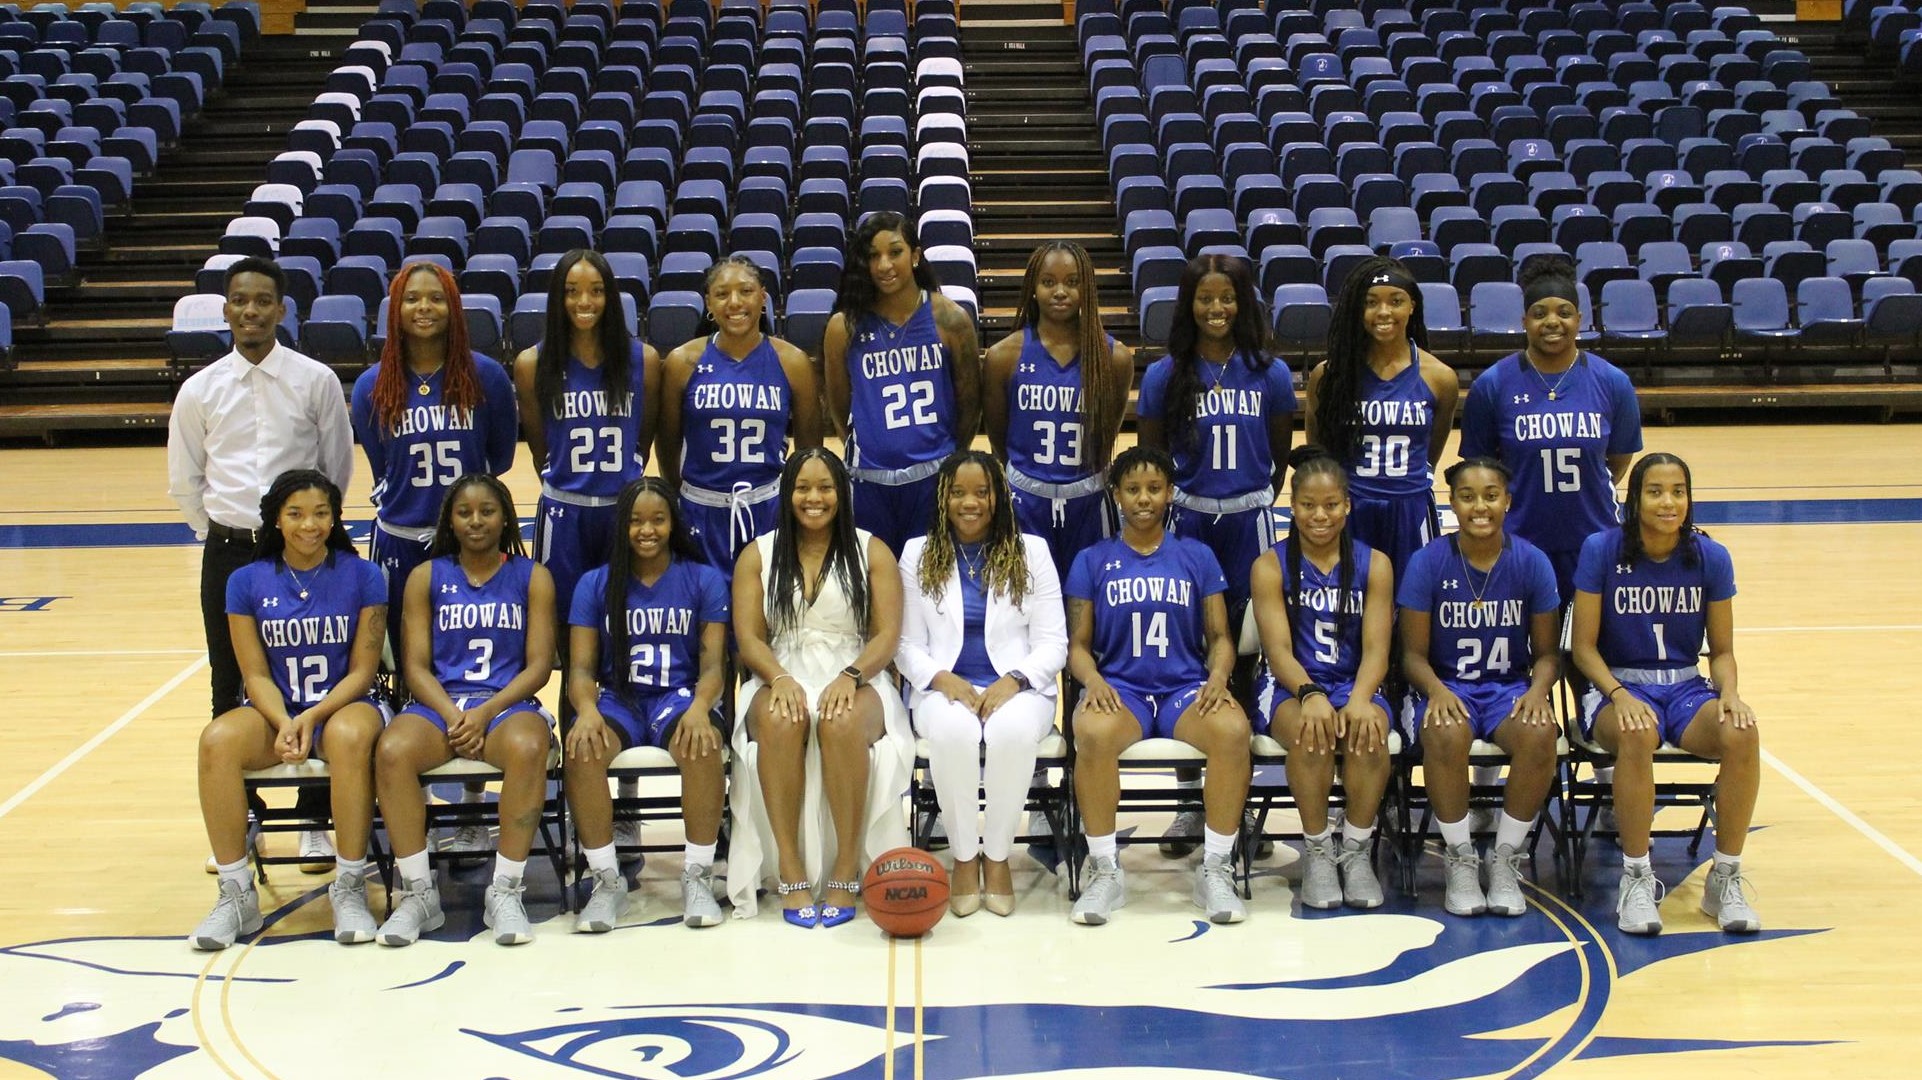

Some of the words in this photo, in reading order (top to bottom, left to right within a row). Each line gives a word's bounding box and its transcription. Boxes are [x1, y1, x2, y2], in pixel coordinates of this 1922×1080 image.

[862, 343, 943, 379] CHOWAN
[694, 383, 781, 411] CHOWAN
[882, 380, 938, 430] 22
[1017, 384, 1087, 413] CHOWA
[1188, 388, 1262, 420] HOWAN
[1345, 400, 1427, 426] OWAN
[710, 418, 766, 463] 32
[1033, 420, 1085, 466] 33
[1515, 412, 1602, 442] CHOWAN
[409, 440, 463, 487] 35
[569, 426, 623, 473] 23
[1212, 424, 1237, 470] 11
[1356, 434, 1411, 477] 30
[1540, 447, 1582, 493] 15
[1106, 577, 1192, 607] CHOWAN
[1287, 588, 1364, 617] HOWAN
[1614, 586, 1702, 615] CHOWAN
[261, 615, 350, 648] CHOWAN
[438, 602, 523, 633] CHOWAN
[1439, 599, 1523, 629] CHOWAN
[1132, 612, 1169, 658] 14
[1315, 618, 1339, 664] 5
[1652, 623, 1667, 660] 1
[464, 638, 494, 682] 3
[628, 643, 671, 687] 21
[1456, 636, 1511, 680] 24
[285, 655, 329, 703] 12
[876, 858, 934, 876] Wilson
[885, 886, 928, 901] NCAA
